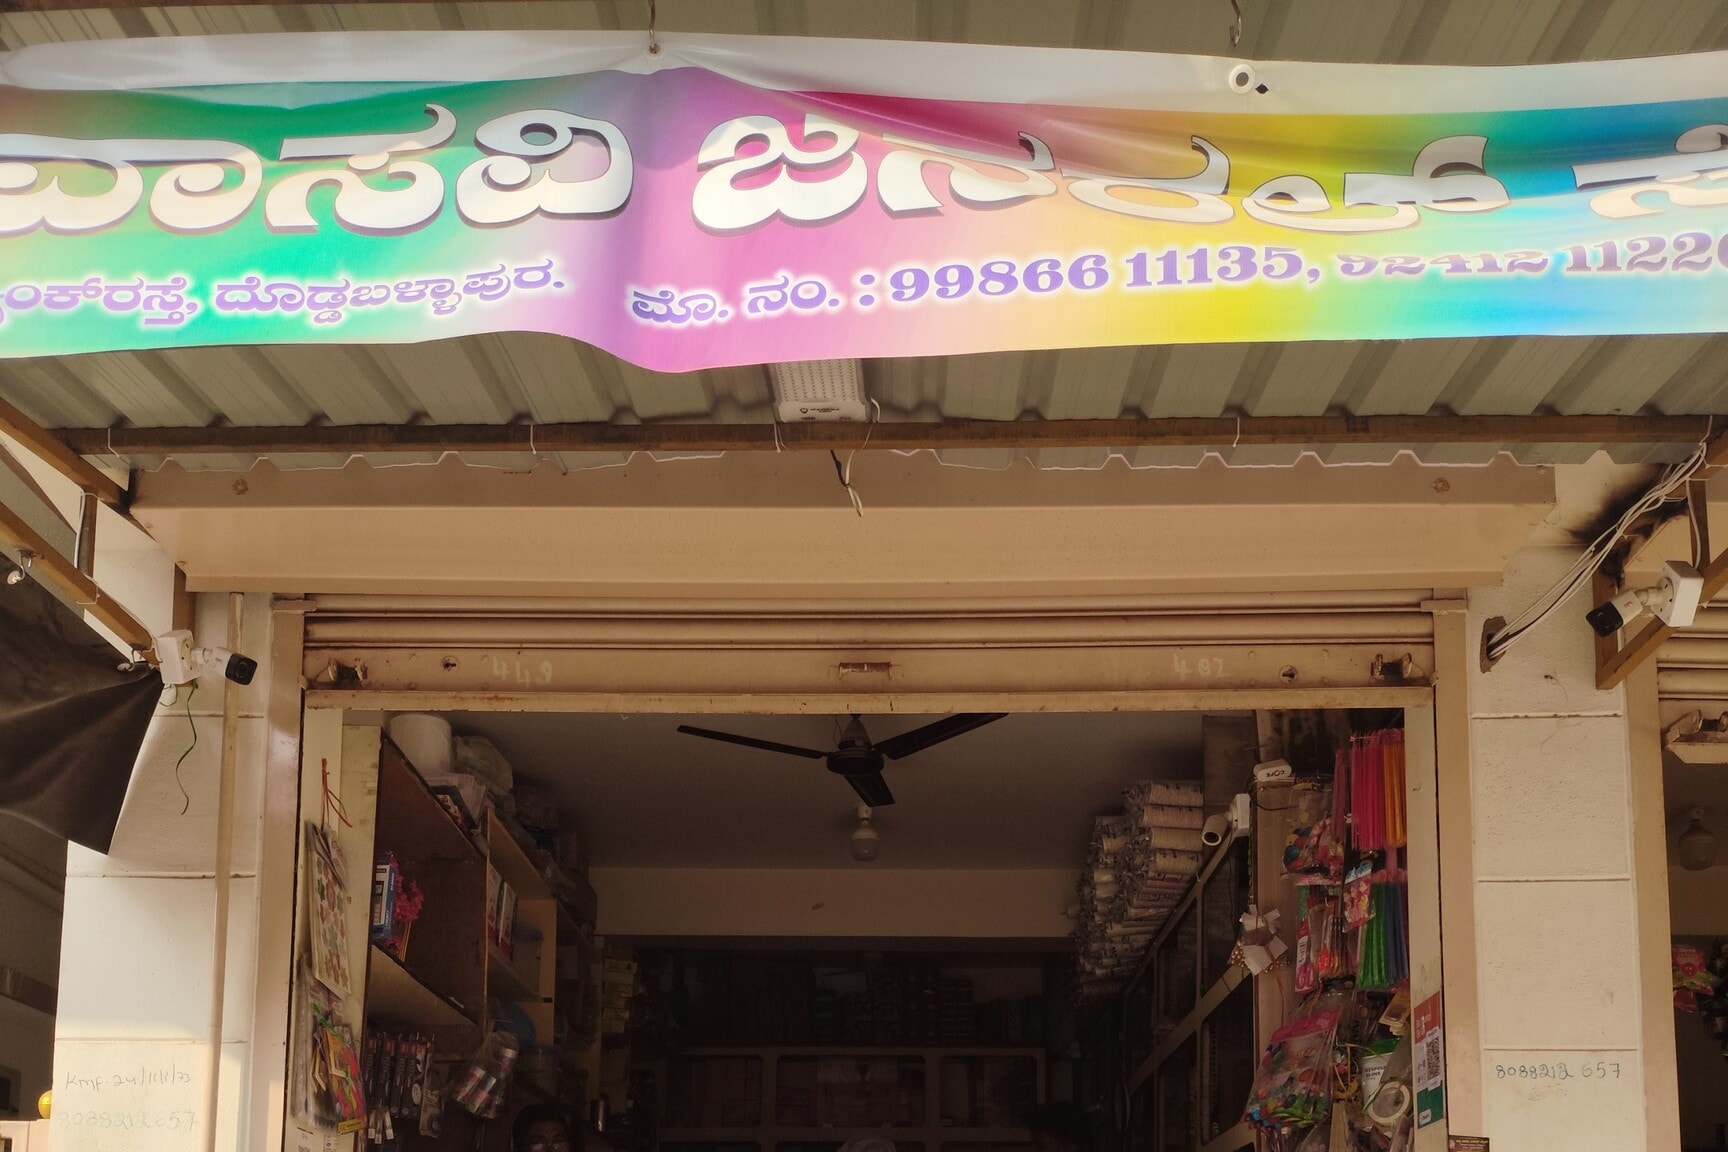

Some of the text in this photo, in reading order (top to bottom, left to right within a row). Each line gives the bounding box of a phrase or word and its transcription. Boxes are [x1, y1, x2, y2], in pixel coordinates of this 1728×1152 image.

[889, 253, 1109, 302] 99866
[1125, 245, 1321, 285] 11135,
[1562, 231, 1728, 272] 1122
